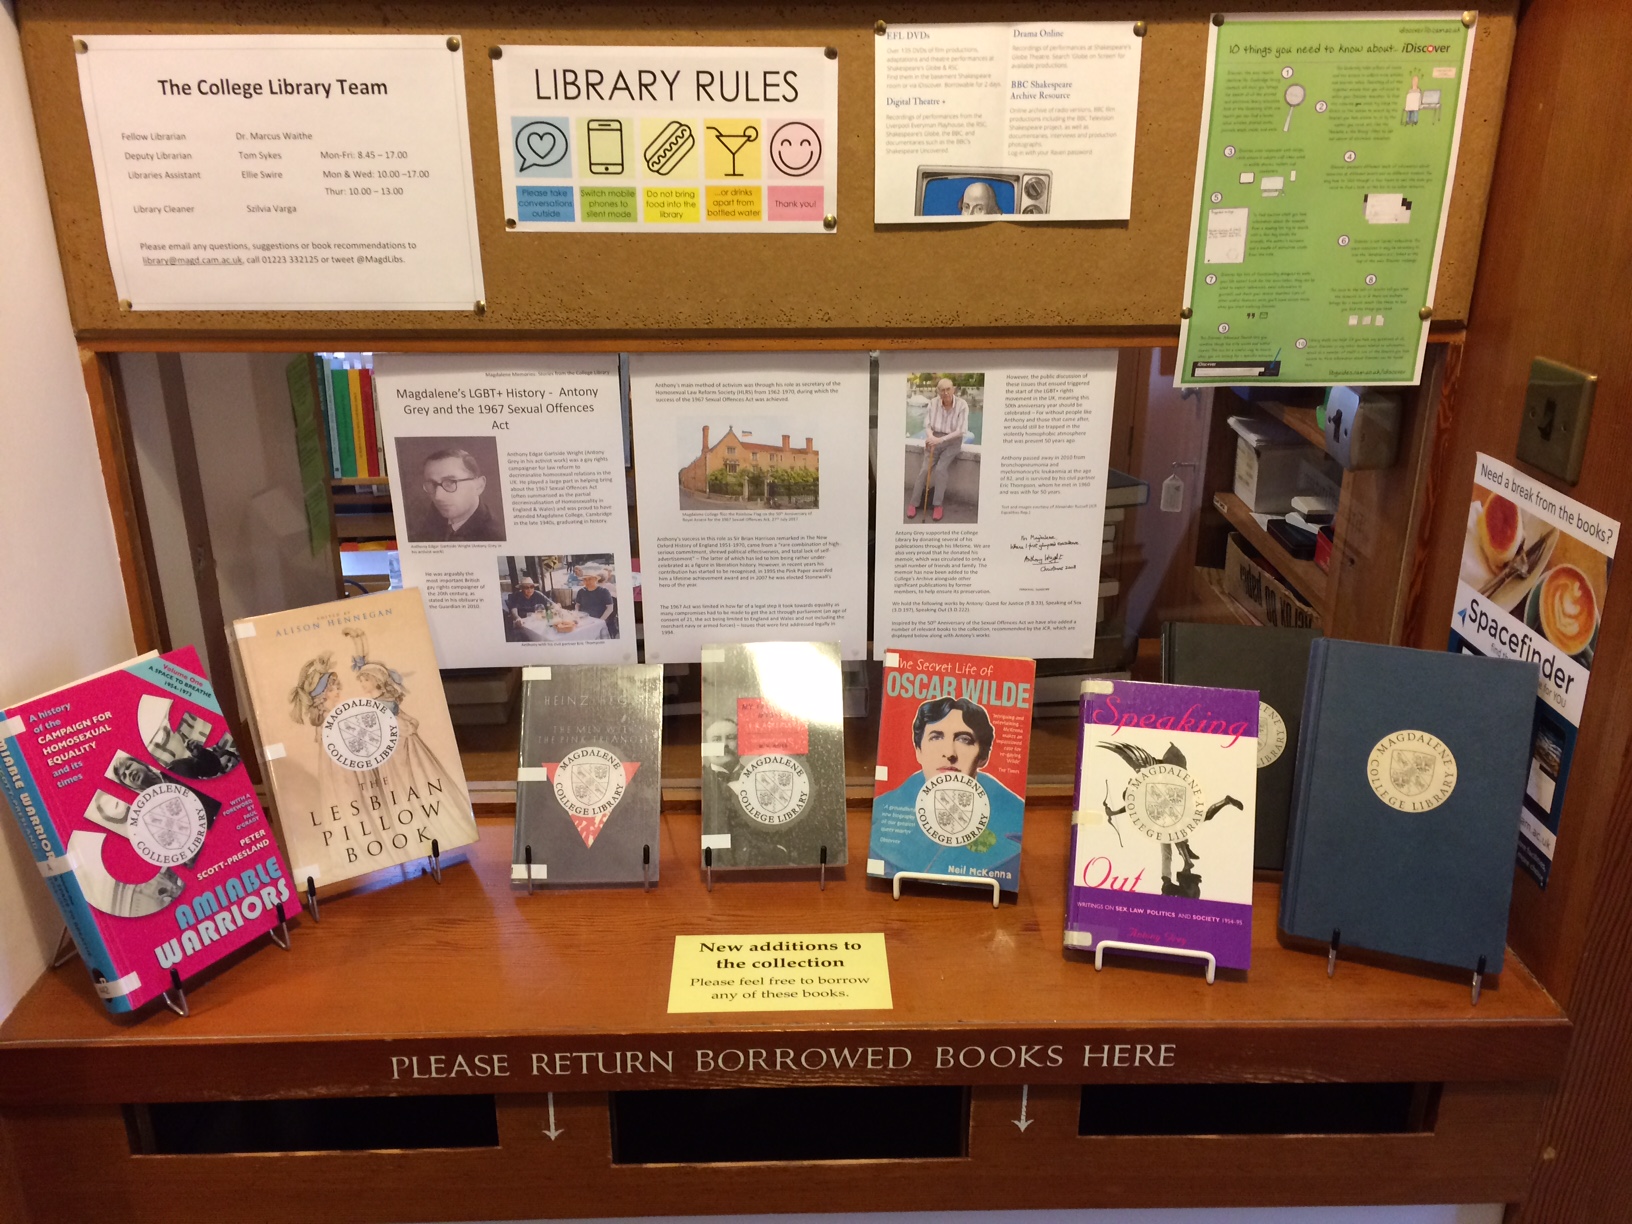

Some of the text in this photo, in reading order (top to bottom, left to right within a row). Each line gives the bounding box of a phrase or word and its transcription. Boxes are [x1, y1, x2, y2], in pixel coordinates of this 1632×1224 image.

[886, 32, 904, 40] EFL
[1013, 29, 1063, 38] Drama Online
[1229, 45, 1240, 54] 10
[1244, 44, 1272, 57] things
[1275, 46, 1292, 57] you
[1297, 44, 1320, 55] need
[1324, 44, 1335, 54] to
[1338, 44, 1363, 54] know
[1402, 43, 1450, 53] iDiscover
[158, 79, 388, 99] The College Library Team
[535, 69, 799, 102] LIBRARY RULES
[1030, 81, 1072, 90] Shakespeare
[886, 97, 940, 107] Digital Theatre
[1010, 92, 1036, 100] Archive
[122, 132, 186, 141] Fellow Librarian
[236, 132, 313, 140] Dr. Marcus Waithe
[125, 152, 192, 161] Deputy Librarian
[259, 152, 282, 161] Sykes
[320, 151, 408, 159] Mon-Fri: 8.45 17.00
[128, 171, 201, 179] Libraries Assistant
[323, 170, 341, 178] Mon
[352, 170, 375, 178] Wed:
[381, 187, 403, 195] 13.00
[522, 189, 567, 197] Please take
[674, 190, 695, 200] bring
[134, 205, 194, 215] Library Cleaner
[246, 205, 297, 215] Szilvia Varga
[518, 200, 573, 208] conversations
[646, 200, 696, 208] food into the
[713, 199, 754, 208] apart from
[775, 200, 816, 210] Thank you!
[532, 210, 560, 218] outside
[660, 210, 683, 220] library
[246, 256, 259, 264] call
[262, 256, 286, 264] 01223
[289, 256, 318, 264] 332125
[332, 256, 354, 264] tweet
[469, 388, 502, 399] LGBT+
[506, 388, 545, 400] History
[559, 387, 598, 398] Antony
[404, 403, 594, 416] Grey and the 1967 Sexual Offences
[492, 420, 509, 430] Act
[1481, 463, 1613, 544] Need a break from the books?
[276, 608, 392, 636] ALISON HENNEGAN
[1469, 600, 1574, 694] Spacefinder
[899, 657, 994, 676] he Secret Life of
[887, 672, 1030, 708] OSCAR WILDE
[326, 700, 387, 730] MAGDALENE
[38, 711, 112, 744] CAMPAIGN FOR
[1092, 696, 1248, 749] Speaking
[42, 724, 112, 756] HOMOSEXUAL
[328, 725, 398, 769] COLLEGE LIBRARY
[1379, 732, 1453, 765] MAGDALENE
[47, 742, 97, 767] EQUALITY
[560, 749, 621, 771] MAGDALENE
[359, 777, 388, 790] THE
[922, 774, 985, 798] MAGDALENE
[1370, 759, 1454, 810] COLLEGE LIBRARY
[310, 779, 442, 826] LESBIAN
[556, 782, 624, 816] COLLEGE LIBRARY
[323, 801, 440, 846] PILLOW
[918, 808, 988, 844] COLLEGE LIBRARY
[240, 830, 266, 847] PETER
[347, 827, 432, 863] BOOK
[197, 839, 269, 880] SCOTT-PRESLAND
[948, 865, 1011, 879] Neil McKenna
[1082, 856, 1145, 892] Out
[175, 856, 282, 930] AMIABLE
[154, 878, 289, 969] WARRIORS
[699, 941, 862, 952] New additions to
[717, 958, 845, 968] the collection
[690, 976, 870, 987] Please feel free to borrow
[711, 989, 848, 1001] any of these books.
[391, 1044, 1176, 1079] PLEASE RETURN BORROWED BOOKS HERE
